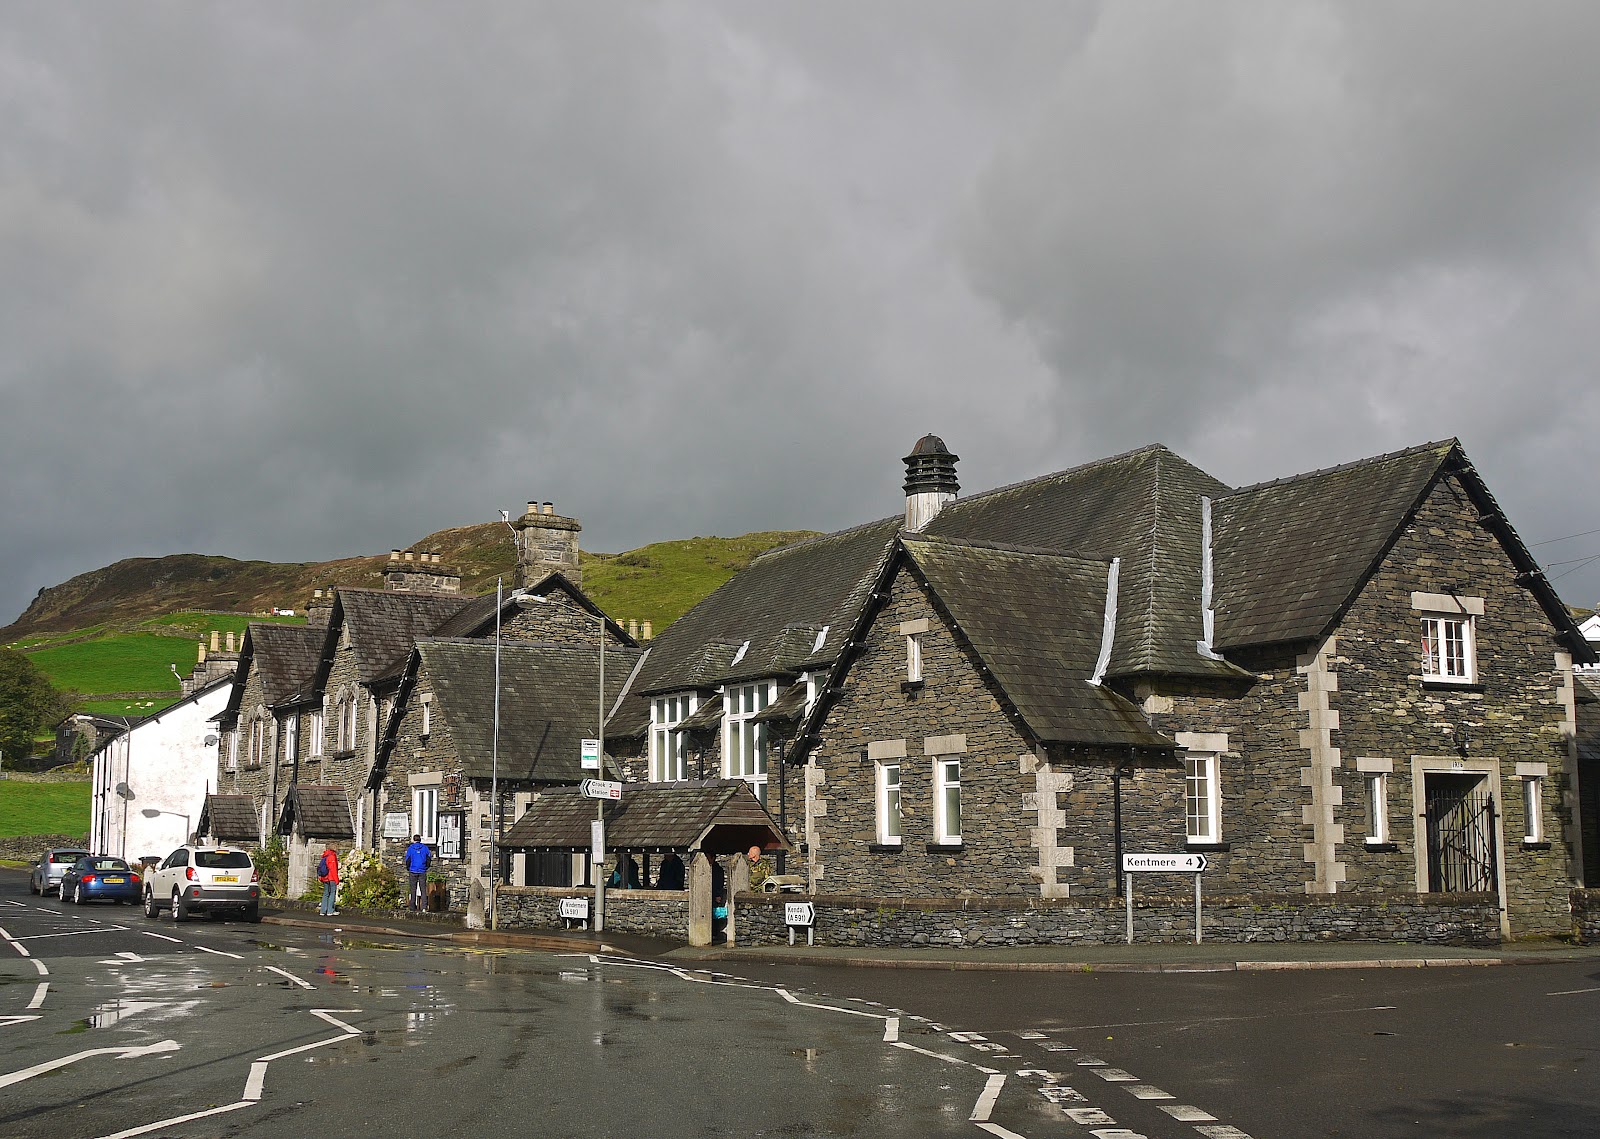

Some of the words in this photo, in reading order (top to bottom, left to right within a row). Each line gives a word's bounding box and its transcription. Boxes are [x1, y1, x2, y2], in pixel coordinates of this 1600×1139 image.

[1127, 857, 1177, 867] Kentmere
[1185, 858, 1193, 866] 4
[565, 901, 587, 909] Windermere
